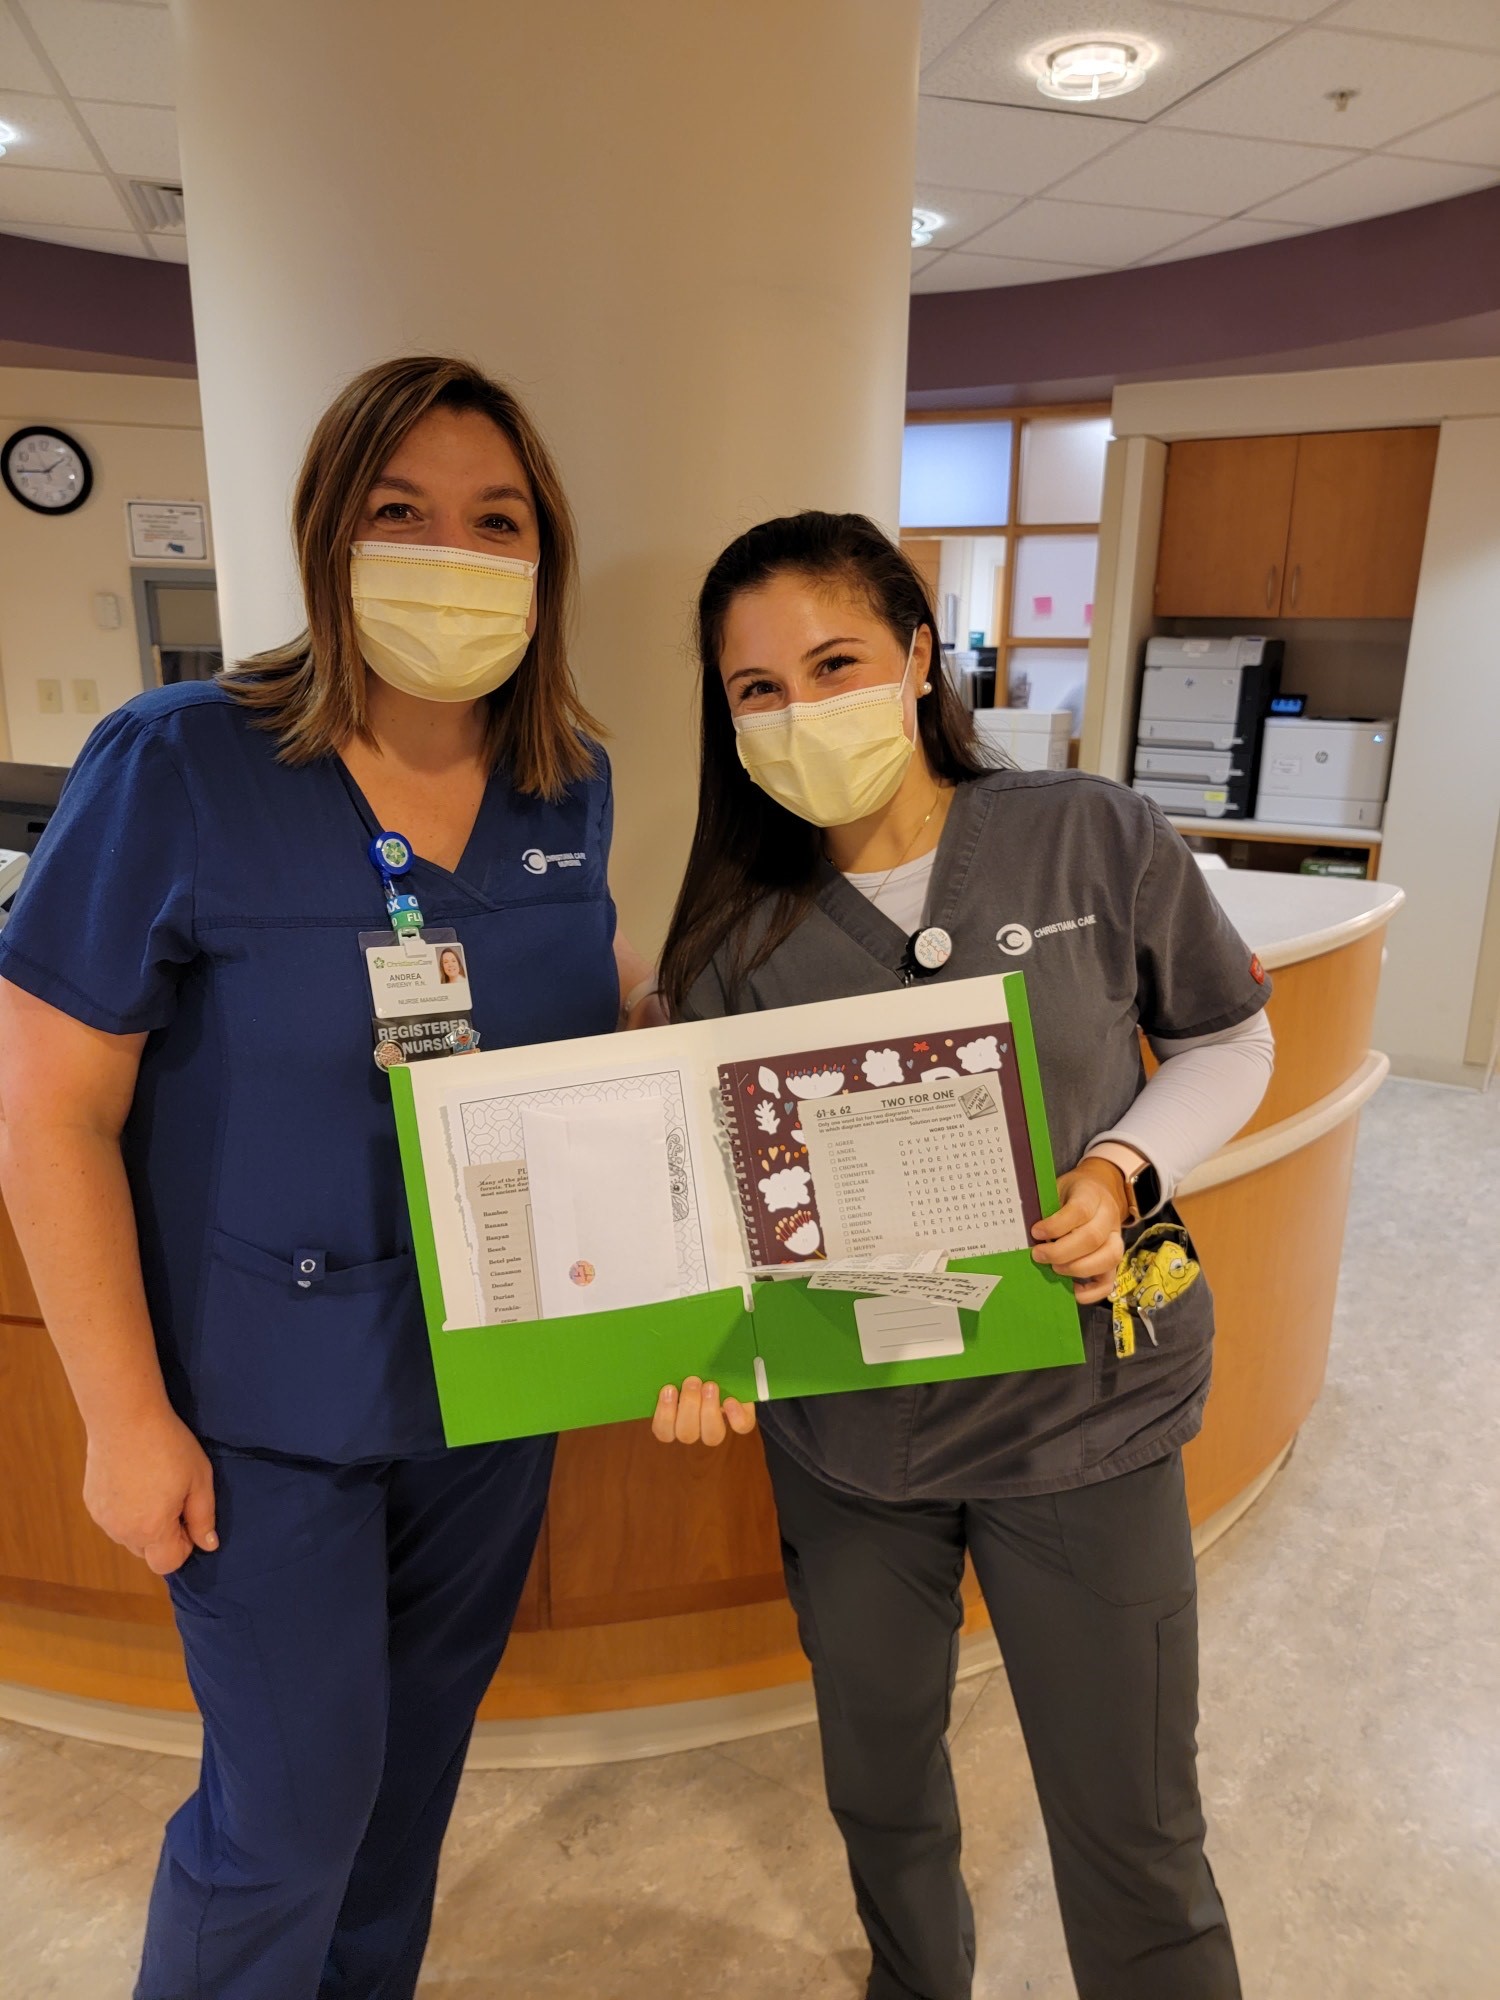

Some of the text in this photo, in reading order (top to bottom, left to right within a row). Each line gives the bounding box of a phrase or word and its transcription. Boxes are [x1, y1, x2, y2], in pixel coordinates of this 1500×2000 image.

[1034, 920, 1078, 938] CHRISTIANA
[390, 973, 422, 982] ANDREA
[420, 995, 448, 1003] MANAGER
[881, 1090, 954, 1108] TWO FOR ONE
[840, 1106, 852, 1114] 62
